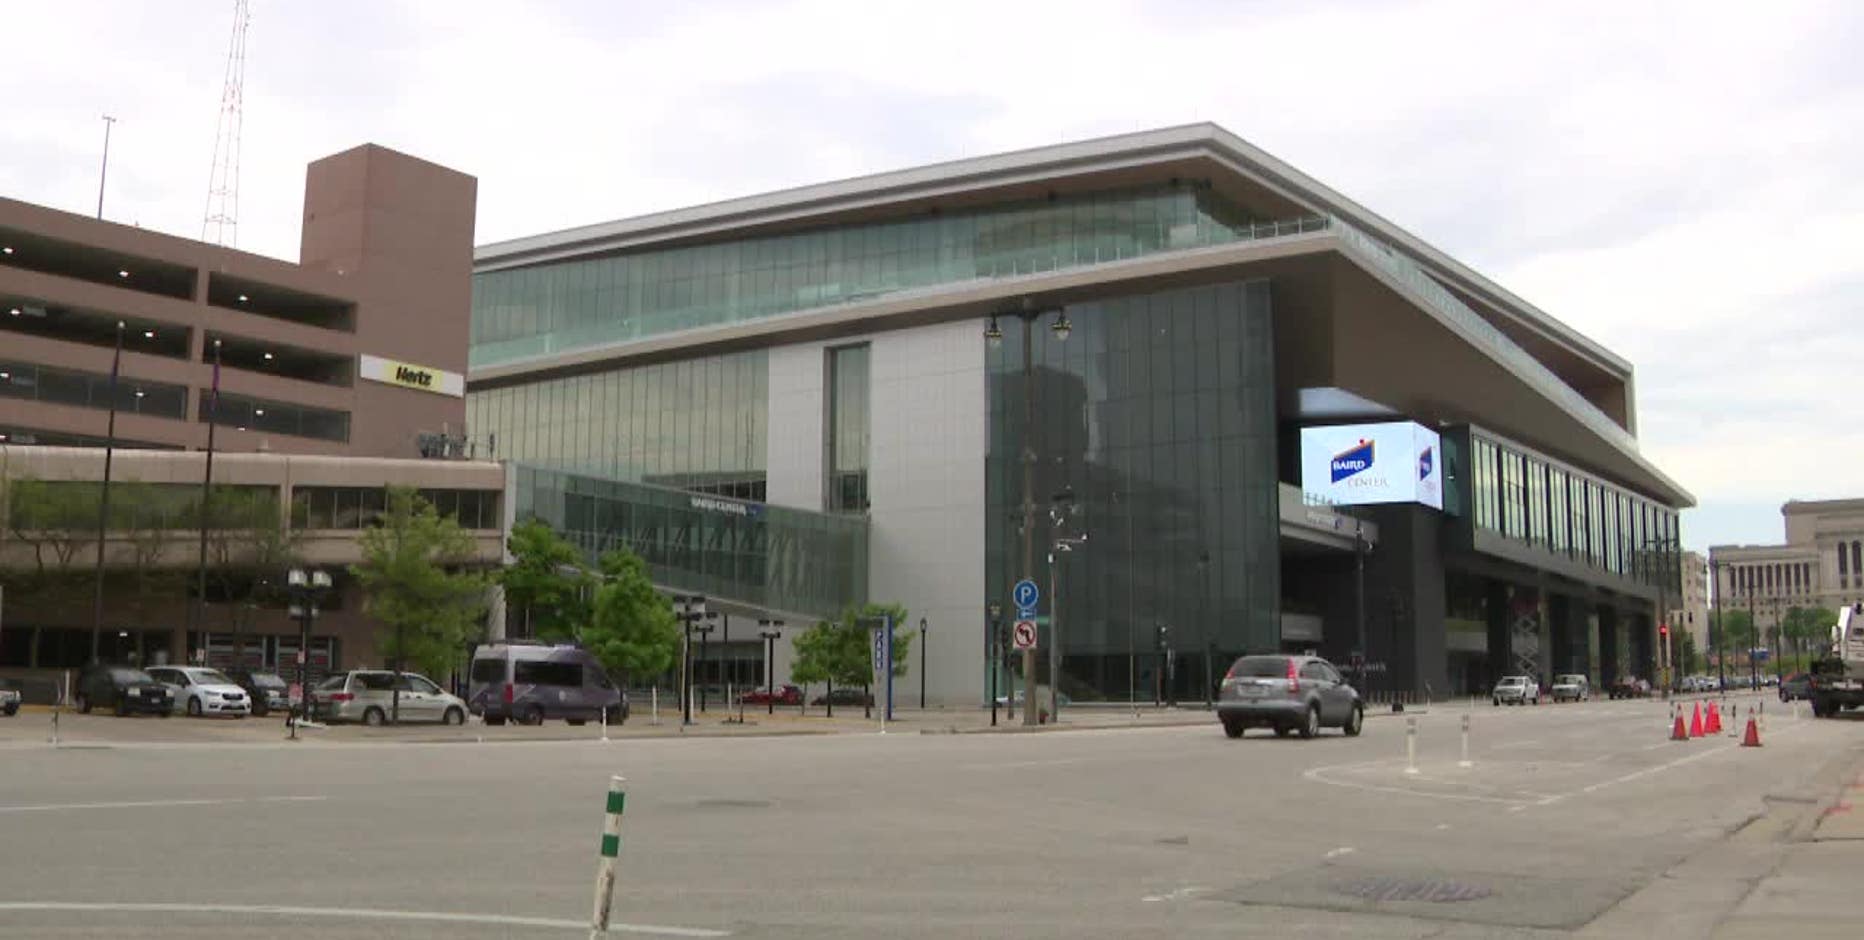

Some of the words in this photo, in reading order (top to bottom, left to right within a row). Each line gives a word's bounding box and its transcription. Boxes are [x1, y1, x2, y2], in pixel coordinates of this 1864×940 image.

[396, 366, 432, 386] Hertz
[1333, 460, 1365, 470] BAIRD
[1348, 476, 1389, 488] CENTER
[1021, 586, 1031, 603] P
